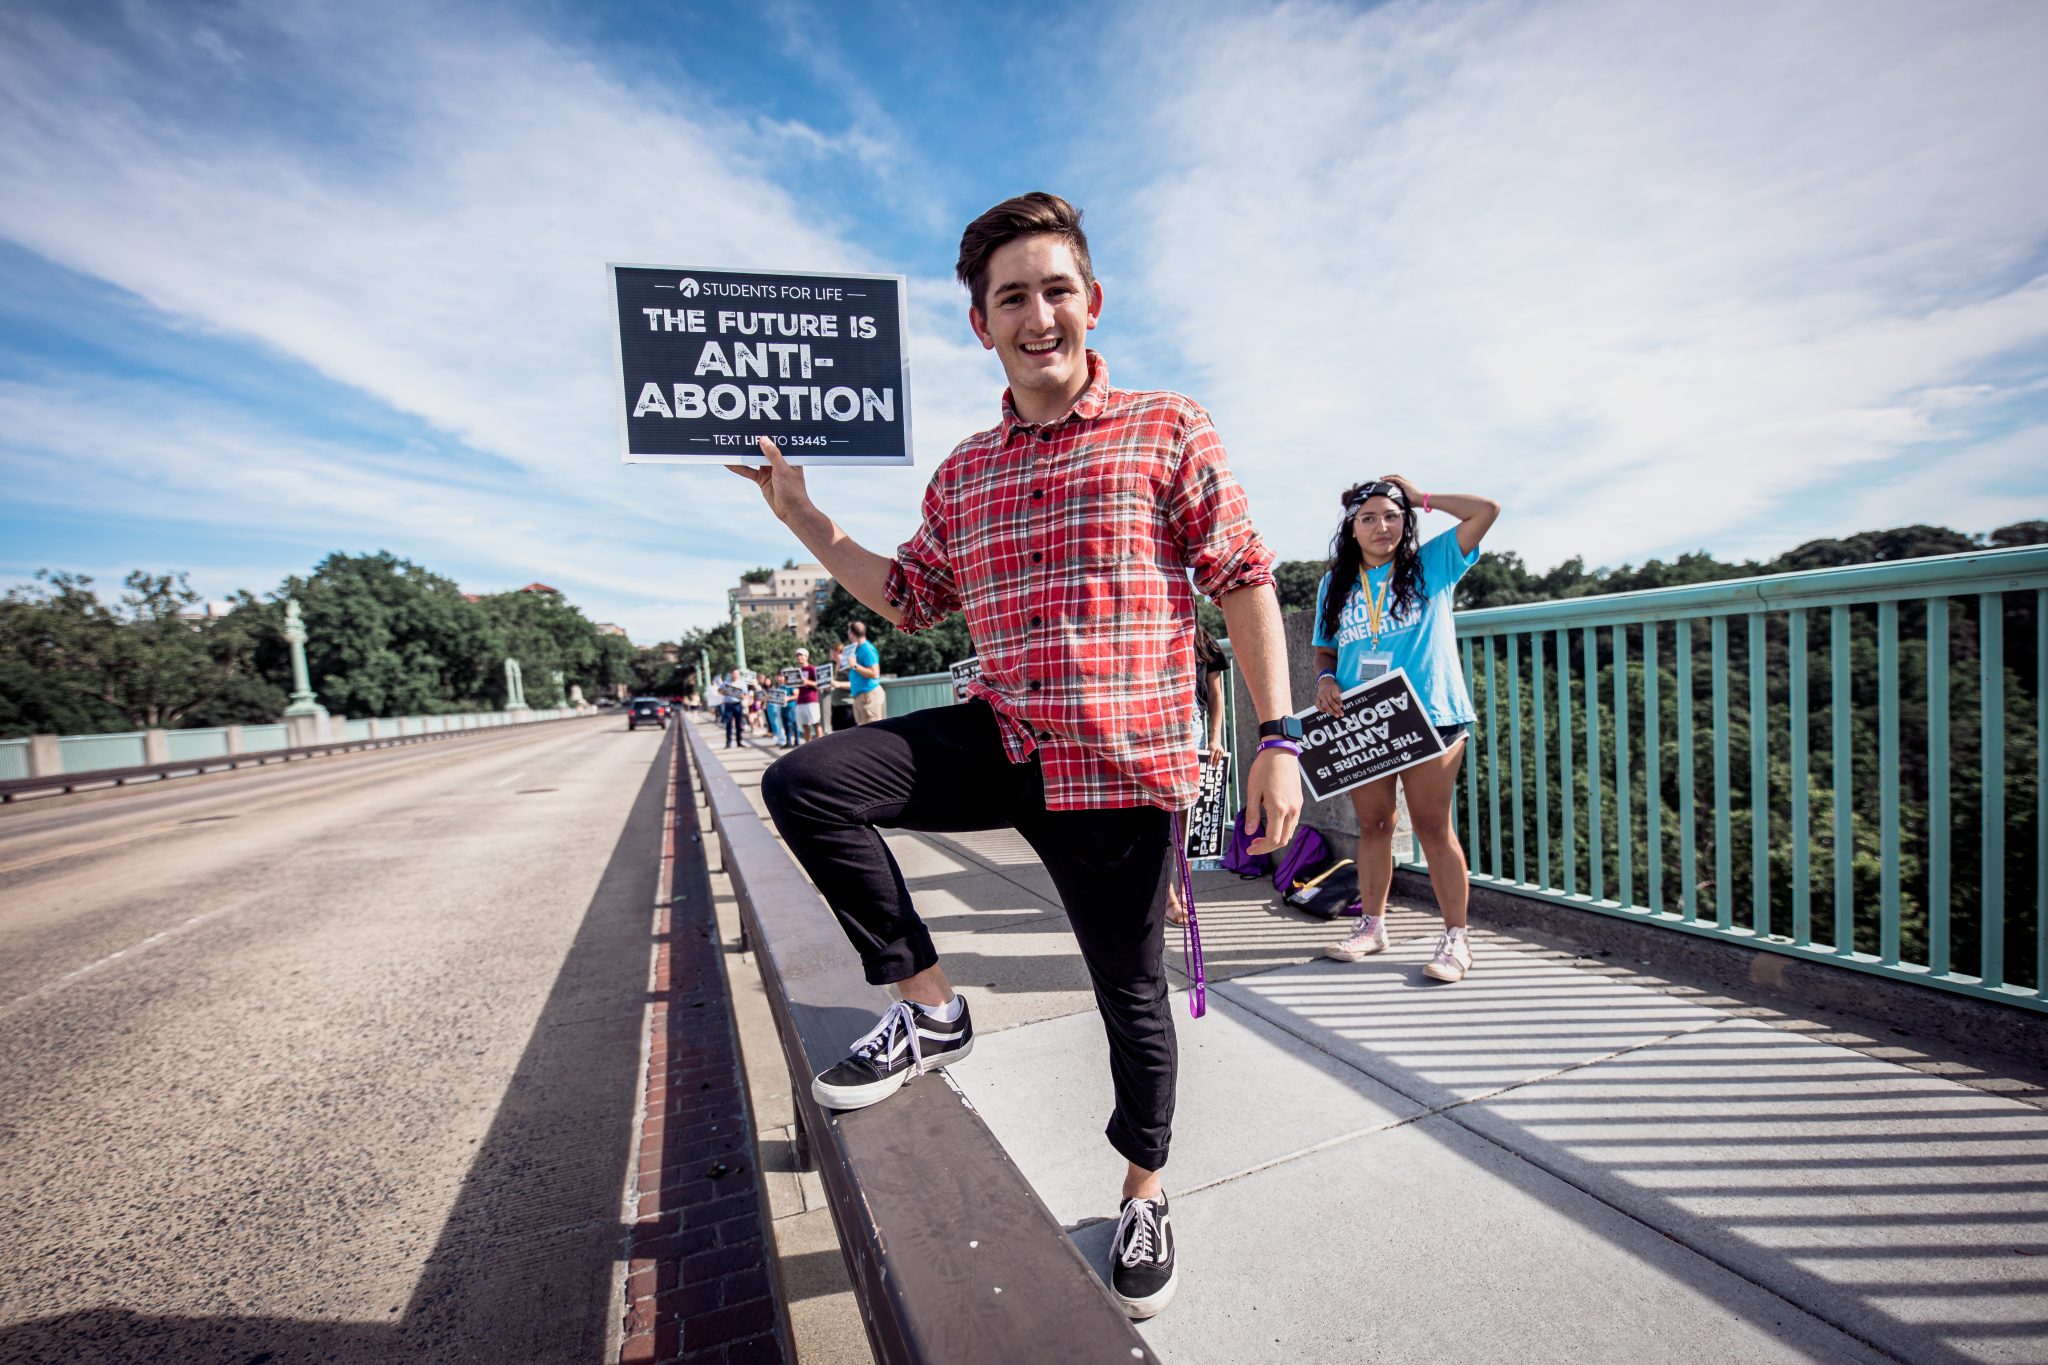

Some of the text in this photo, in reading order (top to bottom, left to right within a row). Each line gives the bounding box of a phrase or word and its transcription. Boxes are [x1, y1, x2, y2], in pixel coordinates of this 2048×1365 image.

[702, 282, 843, 301] STUDENTS FOR LIFE
[642, 307, 877, 339] THE FUTURE IS
[694, 340, 834, 379] ANTI-
[632, 382, 895, 422] ABORTION
[713, 434, 827, 447] TEXT LIF TO 53445
[1353, 695, 1369, 706] TEXT
[1295, 691, 1409, 753] ABORTION
[1328, 720, 1390, 756] ANTI-
[1316, 731, 1423, 779] THE FUTURE IS
[1337, 756, 1401, 785] STUDENTS FOR LIFE
[1194, 807, 1203, 837] AM
[1209, 760, 1225, 853] GENERATION
